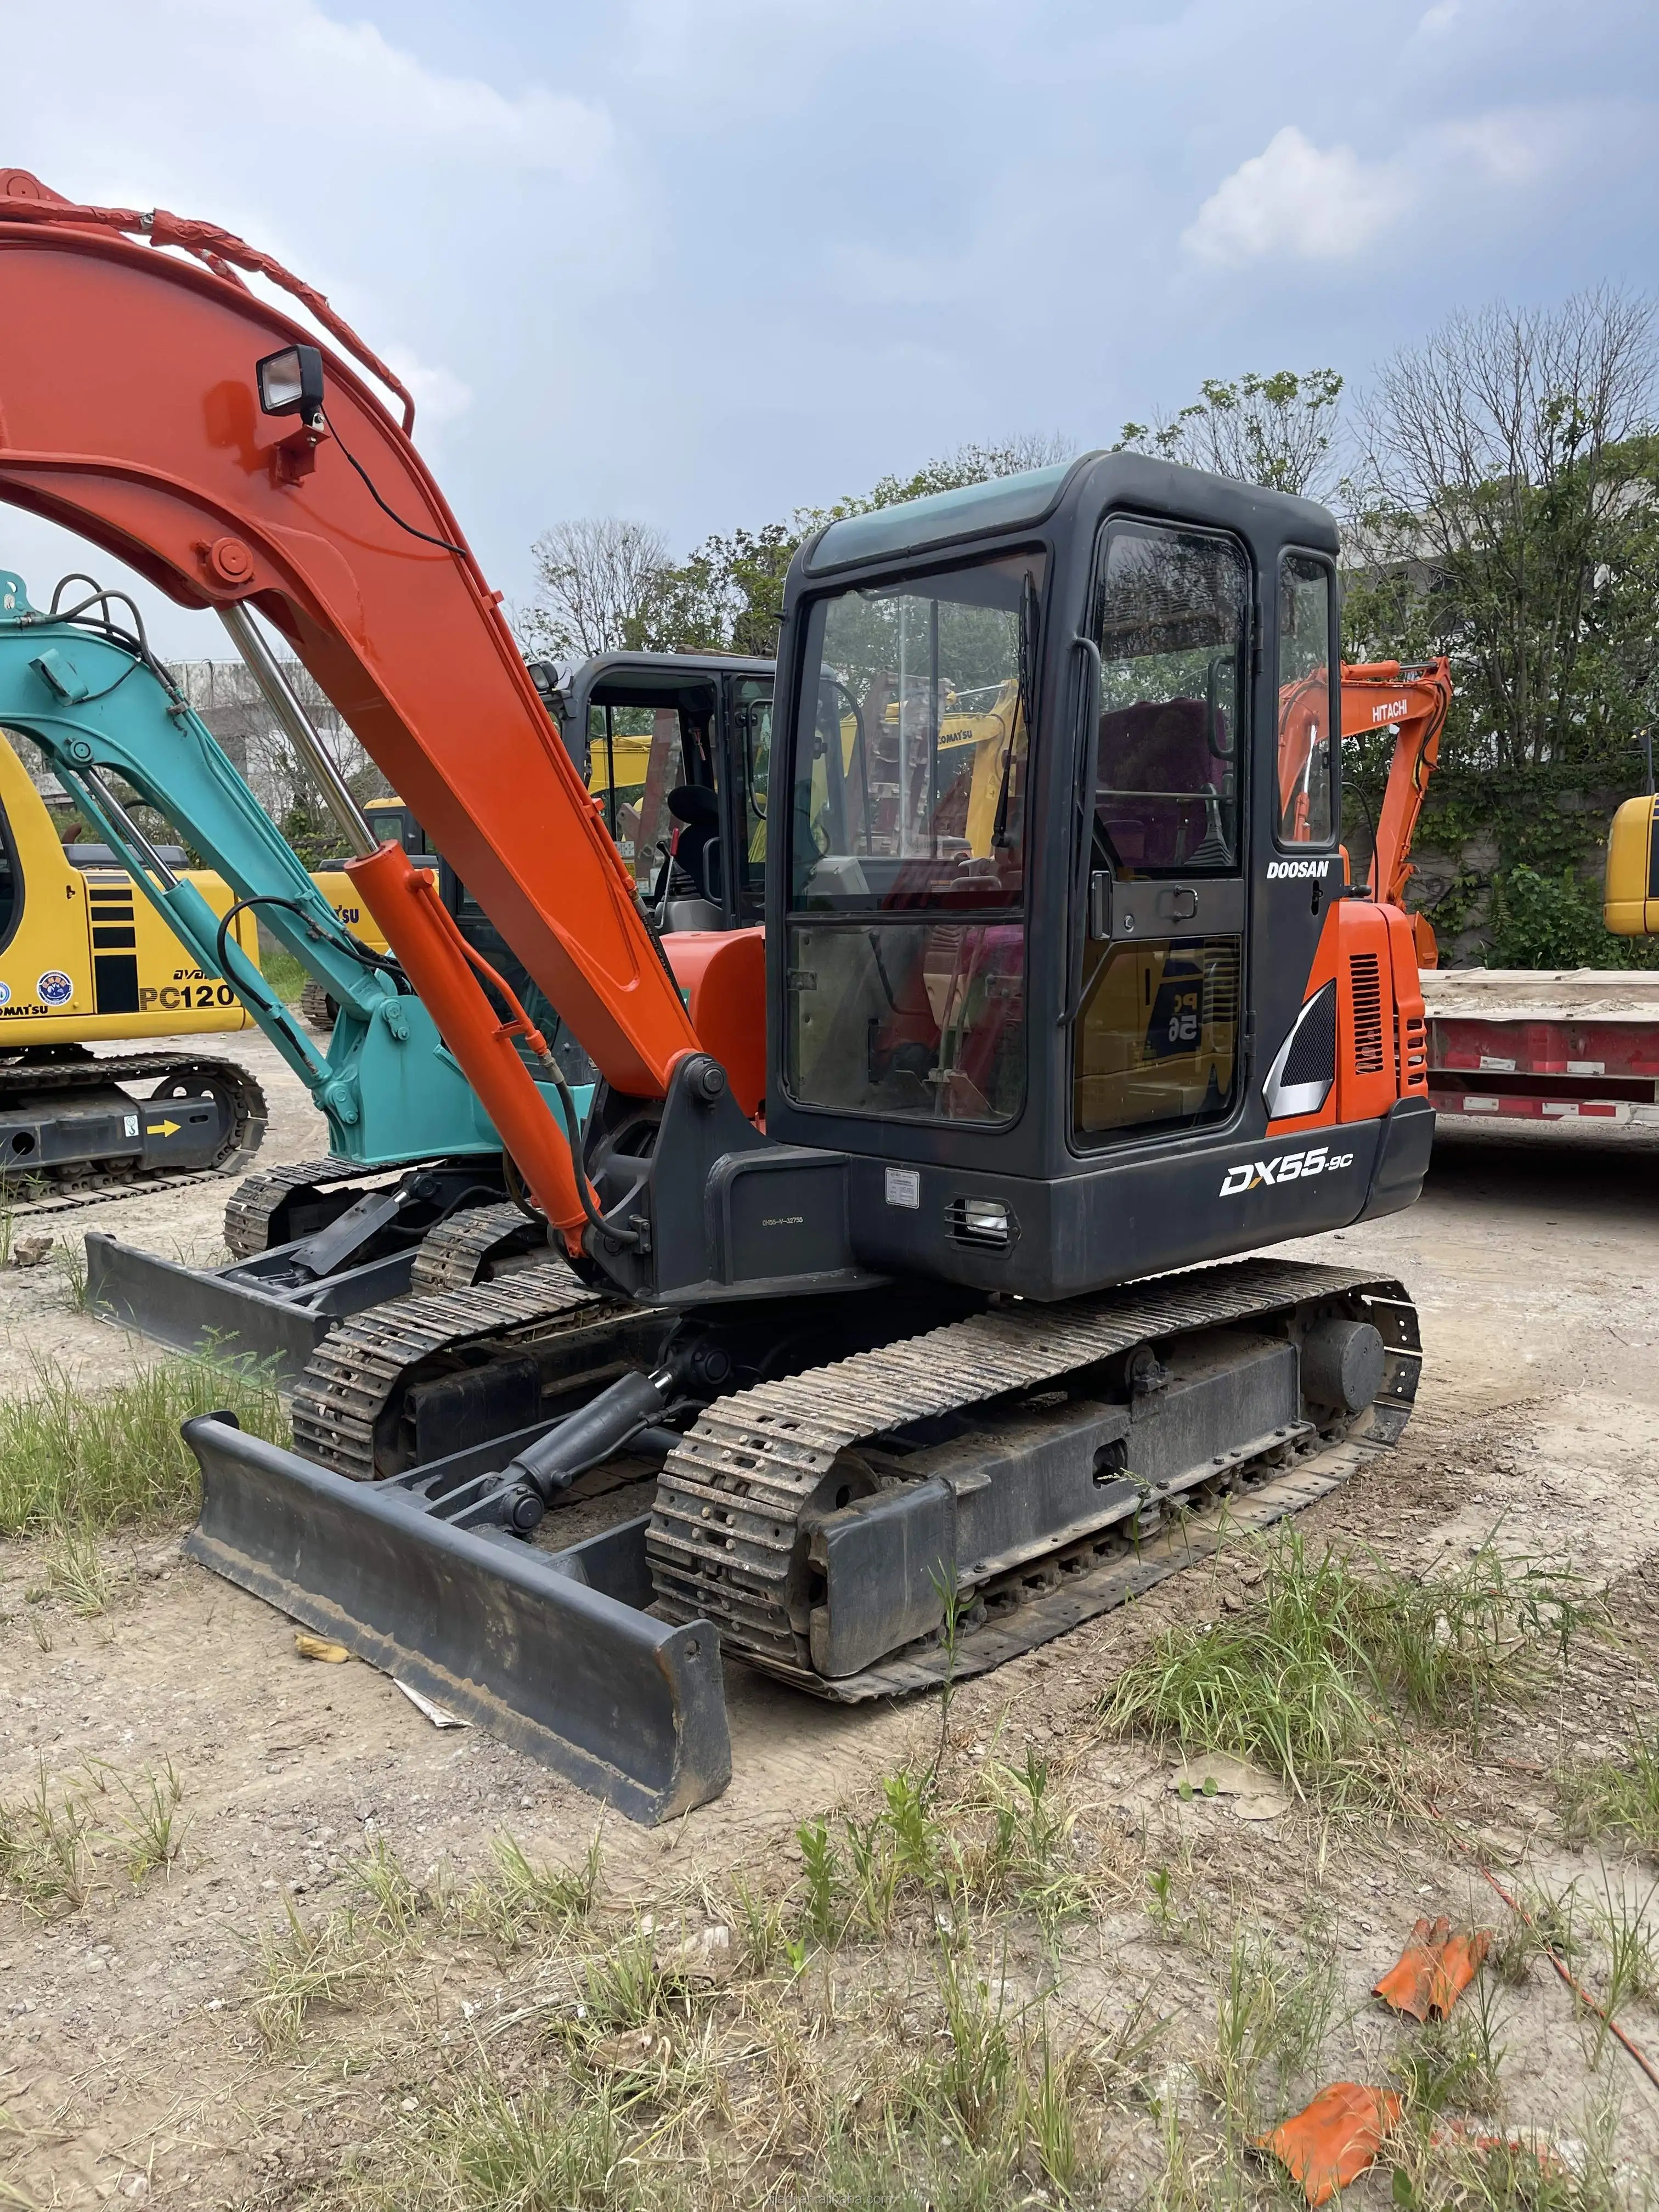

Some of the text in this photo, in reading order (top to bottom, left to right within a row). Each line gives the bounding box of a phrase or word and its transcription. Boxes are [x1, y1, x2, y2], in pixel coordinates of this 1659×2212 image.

[1372, 699, 1407, 723] HITACHI
[1266, 861, 1329, 879] DOOSAN
[173, 969, 207, 980] ava
[139, 986, 234, 1011] PC120
[1219, 1147, 1354, 1197] DX55-9C
